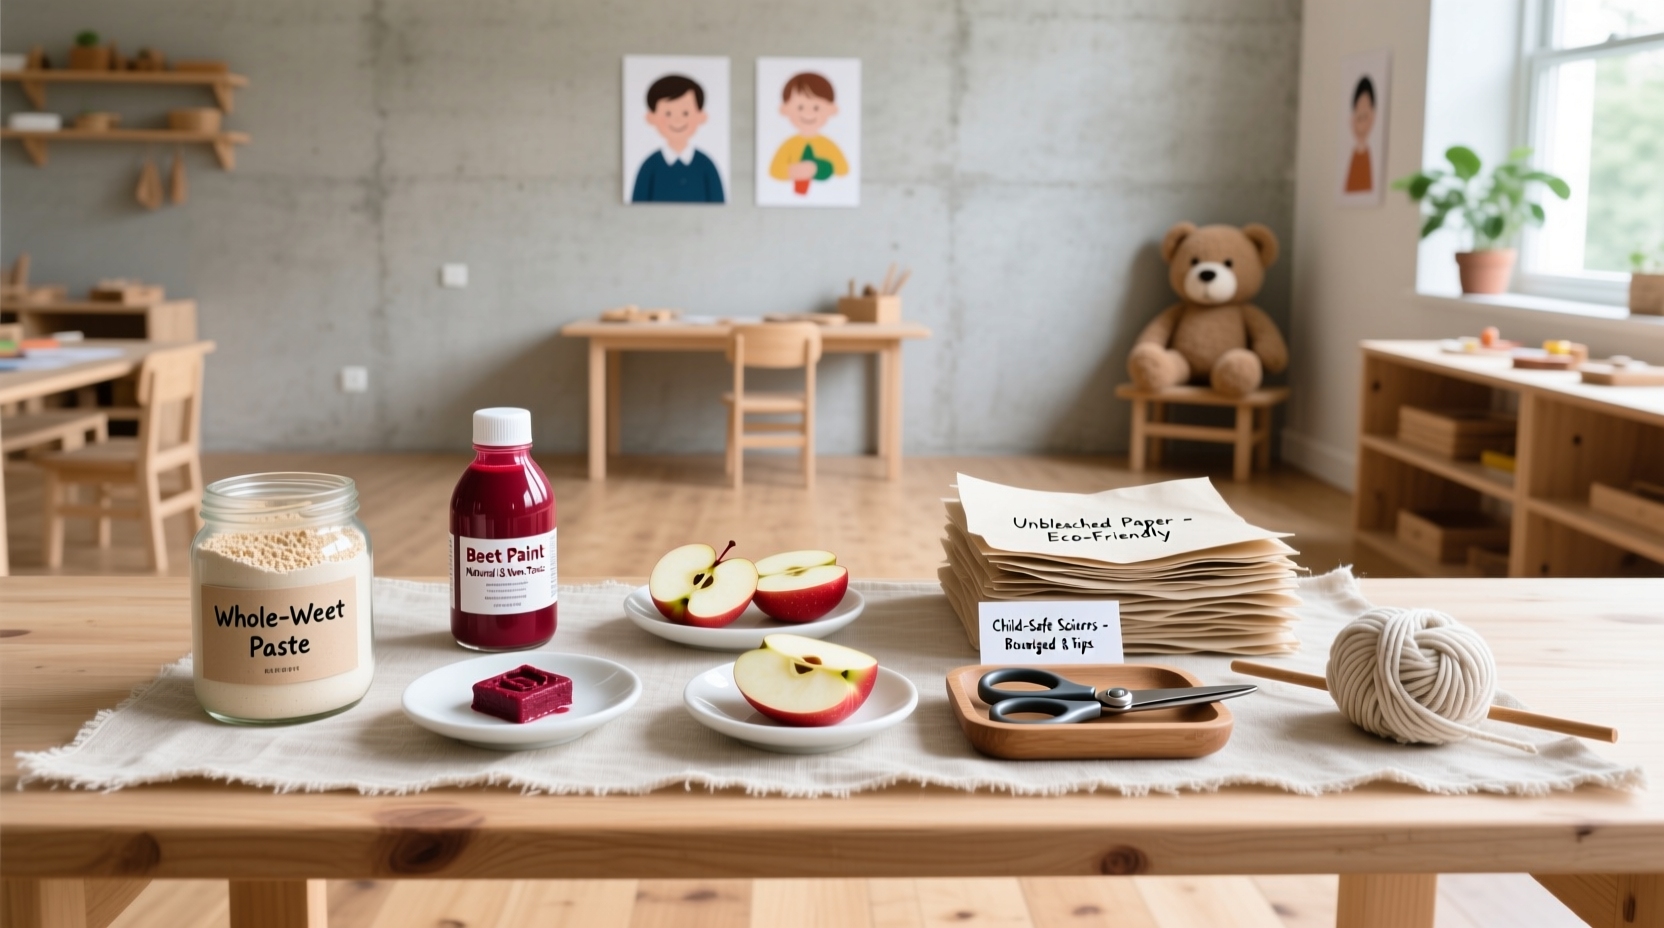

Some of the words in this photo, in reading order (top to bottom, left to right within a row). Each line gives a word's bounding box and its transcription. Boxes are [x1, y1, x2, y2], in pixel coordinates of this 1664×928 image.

[1013, 517, 1112, 530] Unbleached
[1121, 517, 1173, 532] Paper
[1047, 530, 1171, 543] Eco-Friendly
[466, 547, 503, 564] Beet
[507, 544, 546, 563] Paint
[214, 599, 345, 628] Whole-Weet
[992, 617, 1053, 633] Child-Safe
[250, 635, 311, 658] Paste
